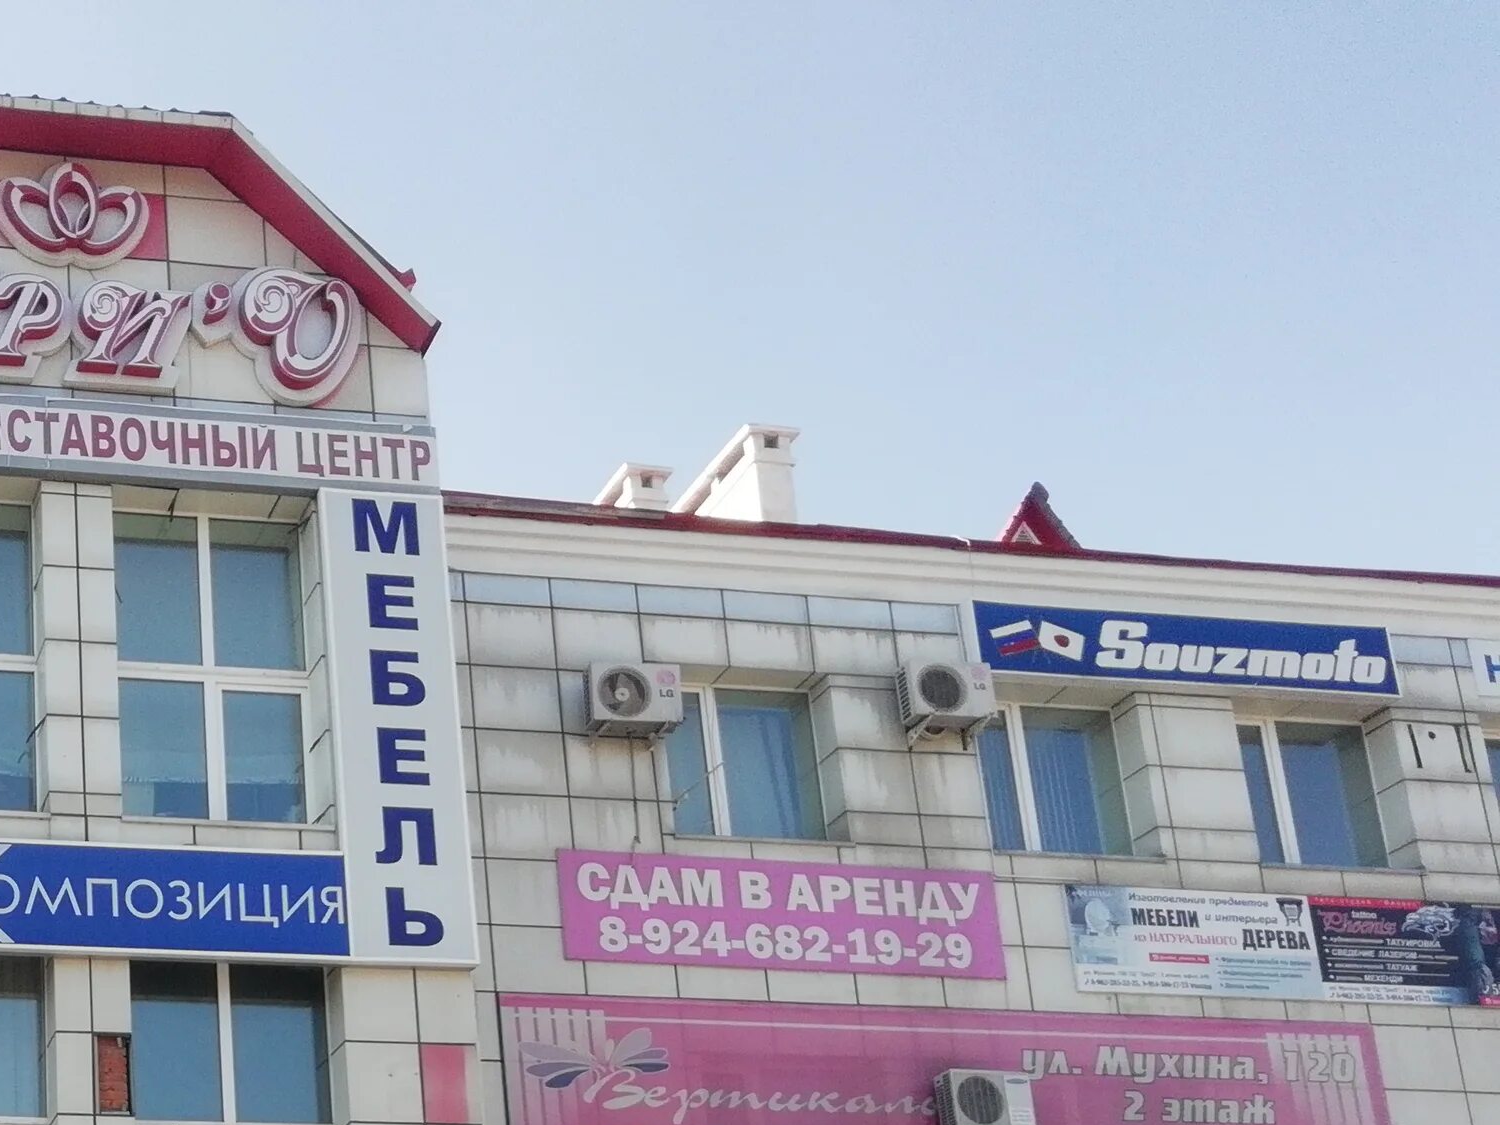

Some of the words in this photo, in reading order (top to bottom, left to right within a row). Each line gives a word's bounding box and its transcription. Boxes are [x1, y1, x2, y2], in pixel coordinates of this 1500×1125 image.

[294, 430, 432, 482] ЦЕНТР
[1095, 619, 1387, 685] Souzmoto
[659, 688, 675, 698] LG
[973, 682, 987, 690] LG
[351, 498, 445, 947] МЕБЕЛЬ
[576, 862, 724, 911] СДАМ
[737, 870, 771, 909] В
[786, 873, 979, 927] АРЕНДУ
[1131, 907, 1200, 928] МЕБЕЛИ
[600, 916, 973, 969] 8-924-682-19-29
[1242, 928, 1311, 951] ДЕРЕВА
[1021, 1048, 1082, 1081] ул.
[1094, 1045, 1269, 1084] Мухина,
[1283, 1049, 1356, 1083] 120
[1122, 1090, 1147, 1122] 2
[1161, 1094, 1276, 1125] этаж
